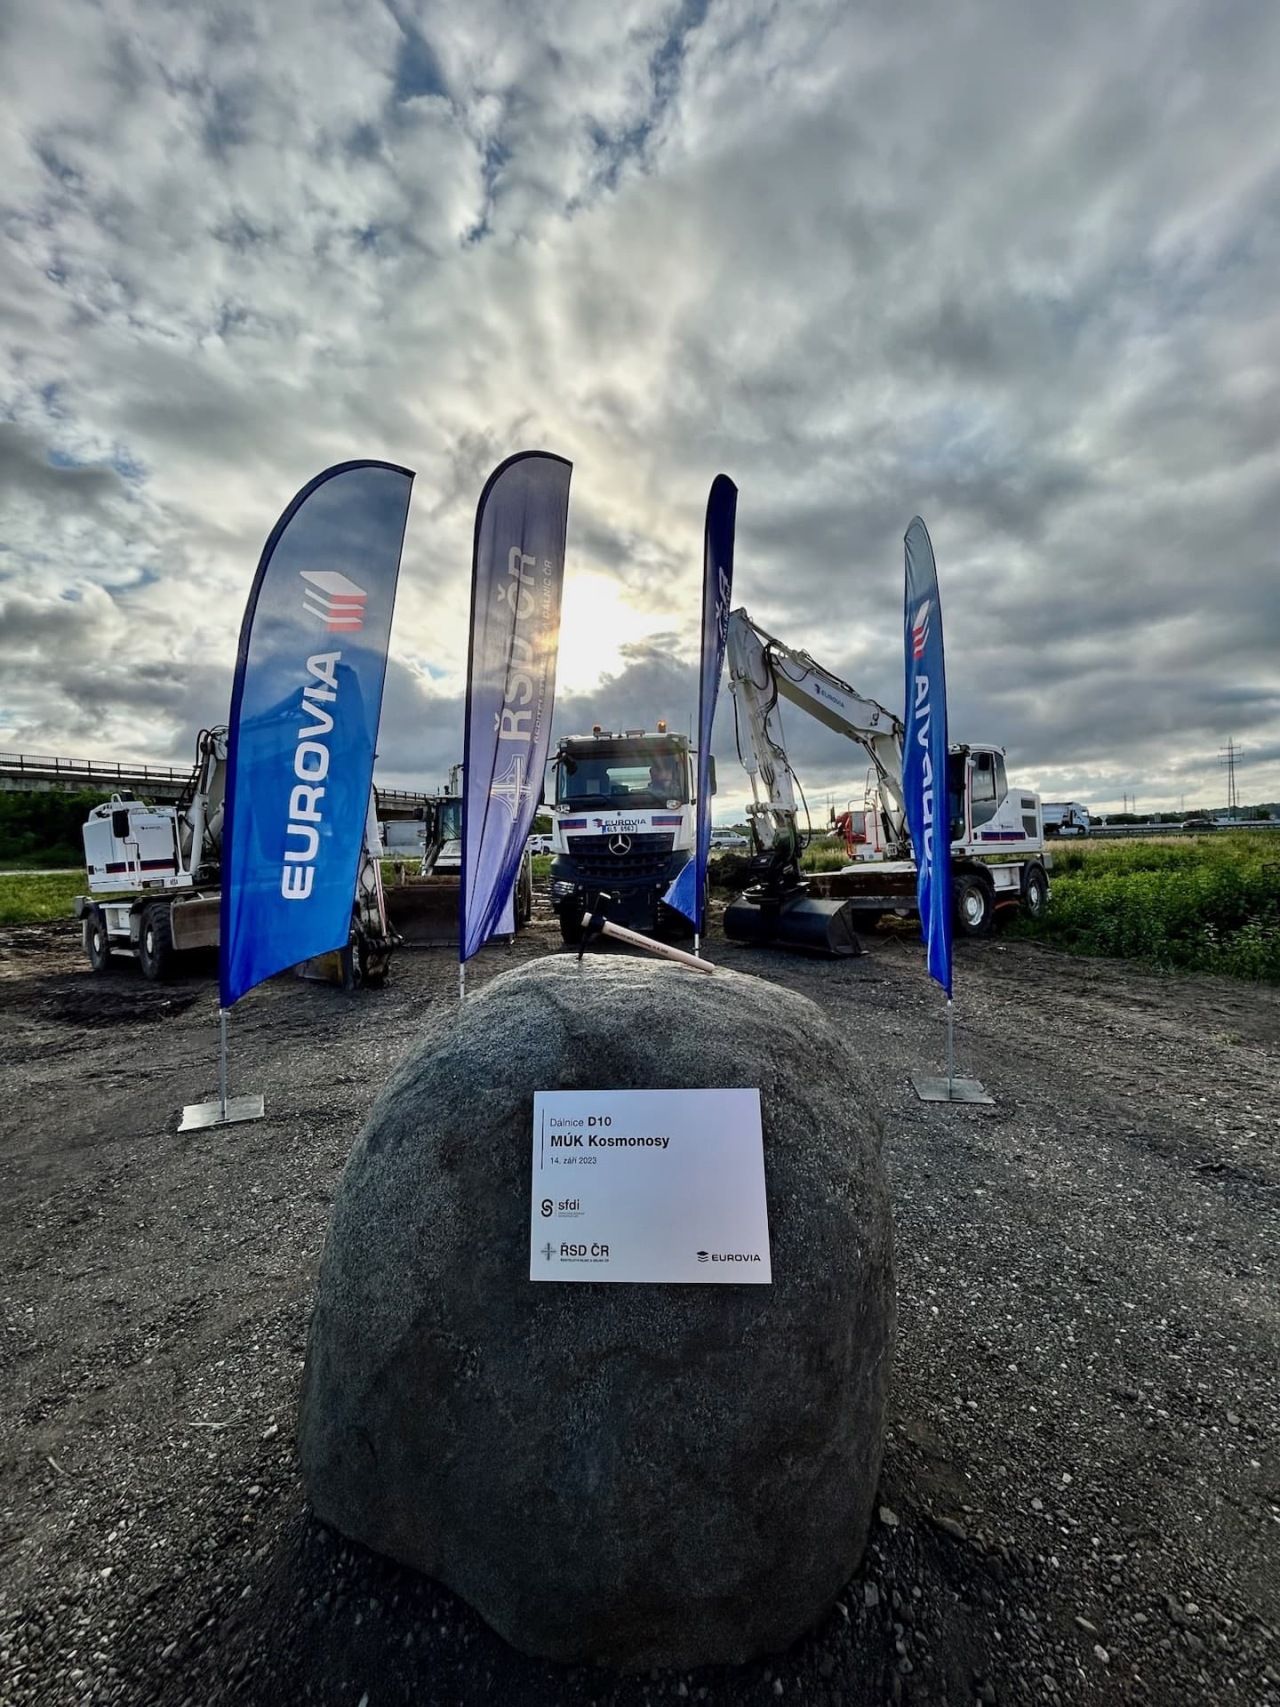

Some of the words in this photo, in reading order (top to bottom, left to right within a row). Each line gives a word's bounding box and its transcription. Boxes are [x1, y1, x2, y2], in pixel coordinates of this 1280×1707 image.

[497, 546, 536, 619] ČR
[494, 633, 533, 741] ŘSD
[281, 651, 342, 899] EUROVIA
[605, 818, 646, 826] EUROVIA
[550, 1117, 584, 1127] Dálnice
[588, 1116, 612, 1127] D10
[550, 1132, 584, 1147] MÚK
[588, 1134, 670, 1149] Kosmonosy
[550, 1157, 561, 1165] 14.
[563, 1156, 577, 1165] září
[579, 1156, 597, 1165] 2023
[558, 1199, 580, 1210] sfdi
[560, 1242, 587, 1256] ŘSD
[591, 1242, 609, 1257] ČR
[711, 1254, 761, 1262] EUROVIA
